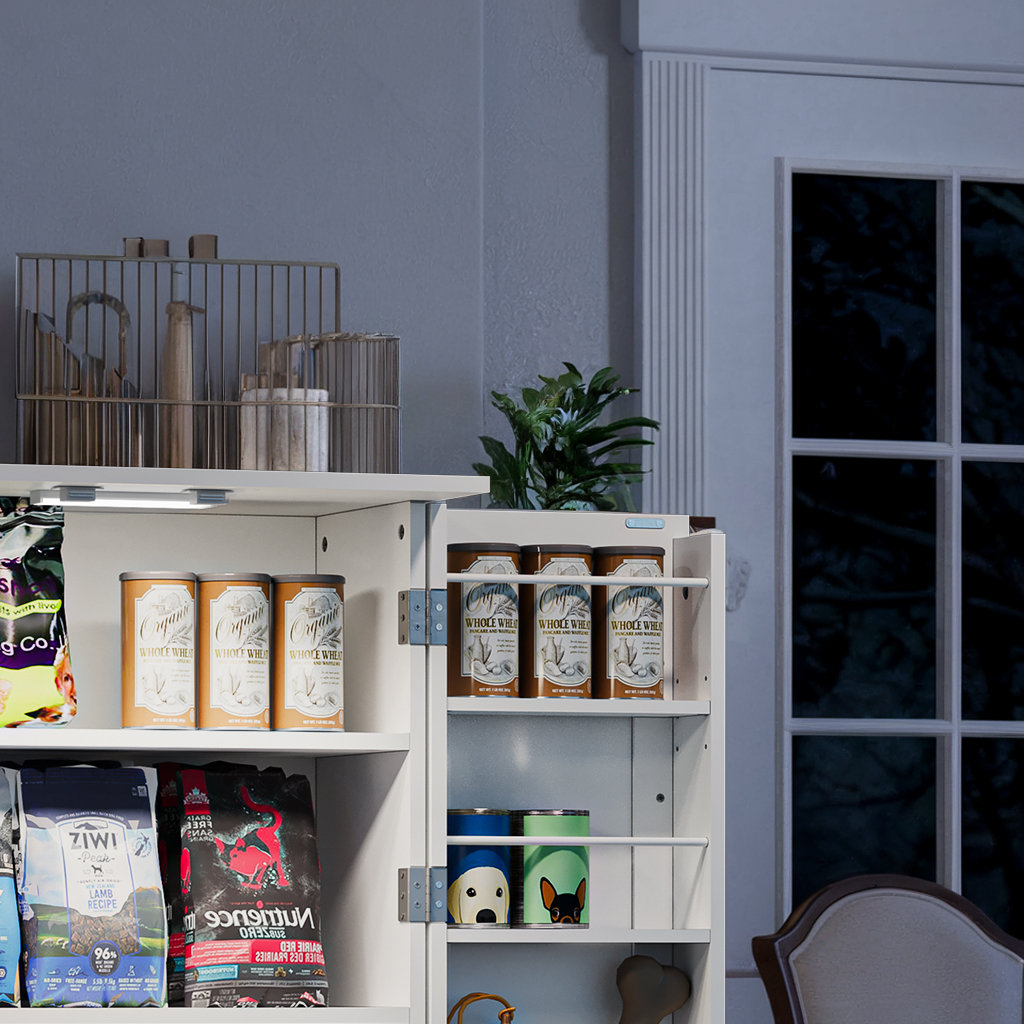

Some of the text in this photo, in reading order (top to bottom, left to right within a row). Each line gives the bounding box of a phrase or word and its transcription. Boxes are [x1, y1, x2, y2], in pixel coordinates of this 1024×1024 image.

[13, 604, 36, 615] with
[465, 618, 496, 628] WHOLE
[538, 620, 569, 629] WHOLE
[611, 621, 642, 630] WHOLE
[140, 647, 170, 657] WHOLE
[215, 649, 245, 659] WHOLE
[289, 650, 320, 660] WHOLE
[69, 832, 117, 850] ZIWI
[90, 889, 113, 899] LAMB
[88, 900, 117, 909] RECIPE
[94, 947, 117, 960] 96%
